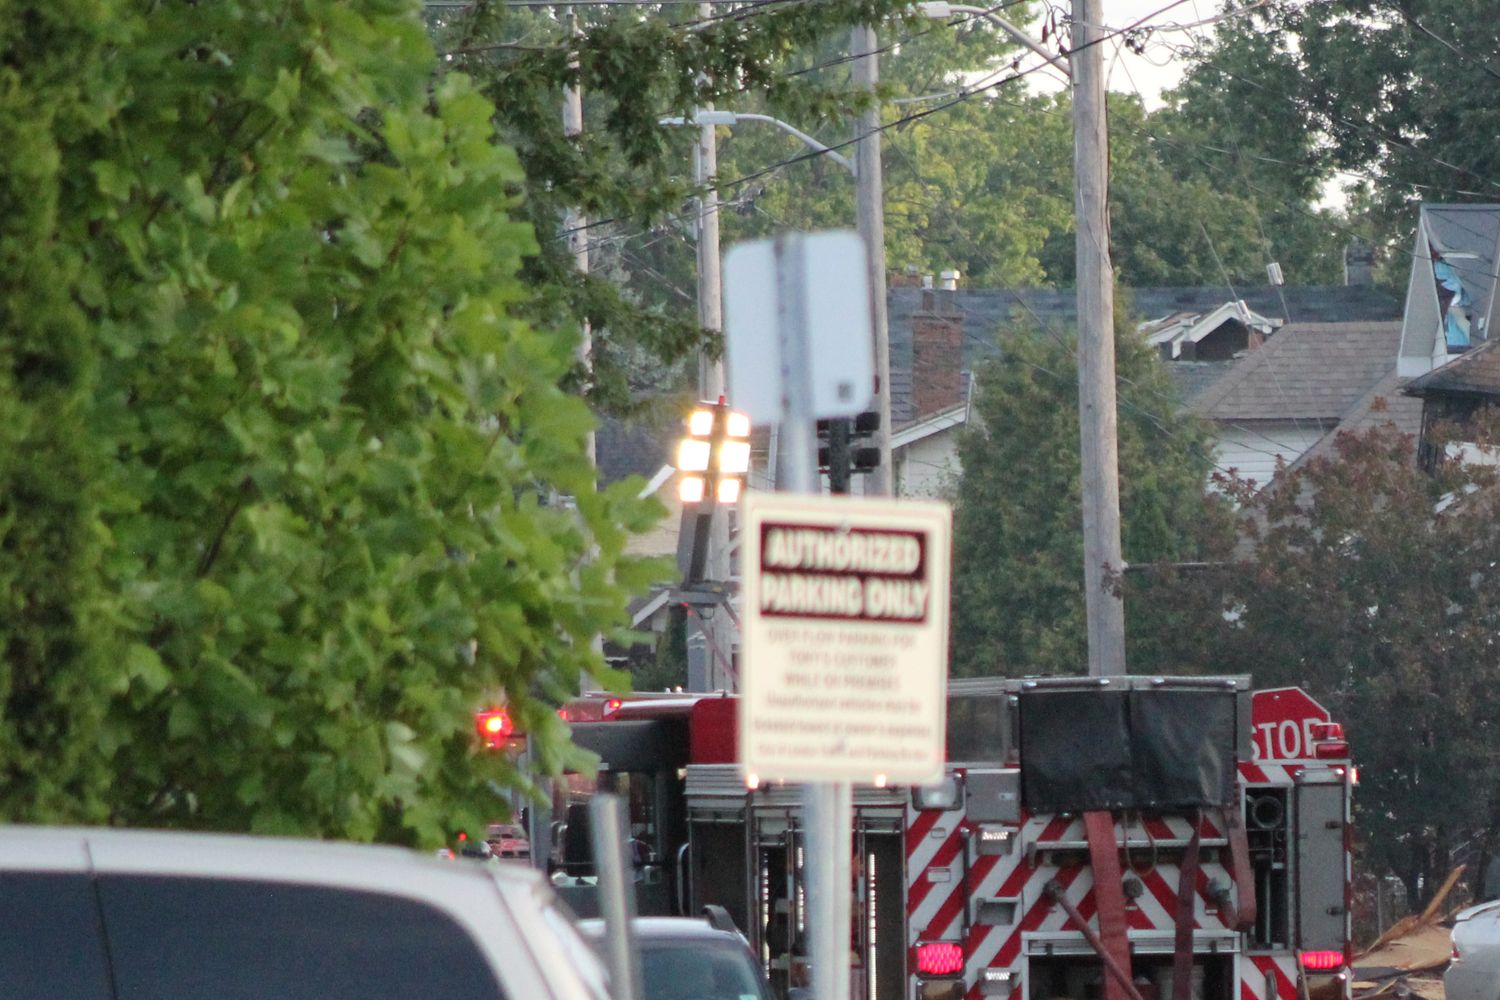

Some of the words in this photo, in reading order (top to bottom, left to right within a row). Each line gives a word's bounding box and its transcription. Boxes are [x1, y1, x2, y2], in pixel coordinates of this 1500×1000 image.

[765, 527, 921, 575] AUTHORIZED
[761, 573, 863, 616] PARKING
[864, 576, 928, 619] ONLY
